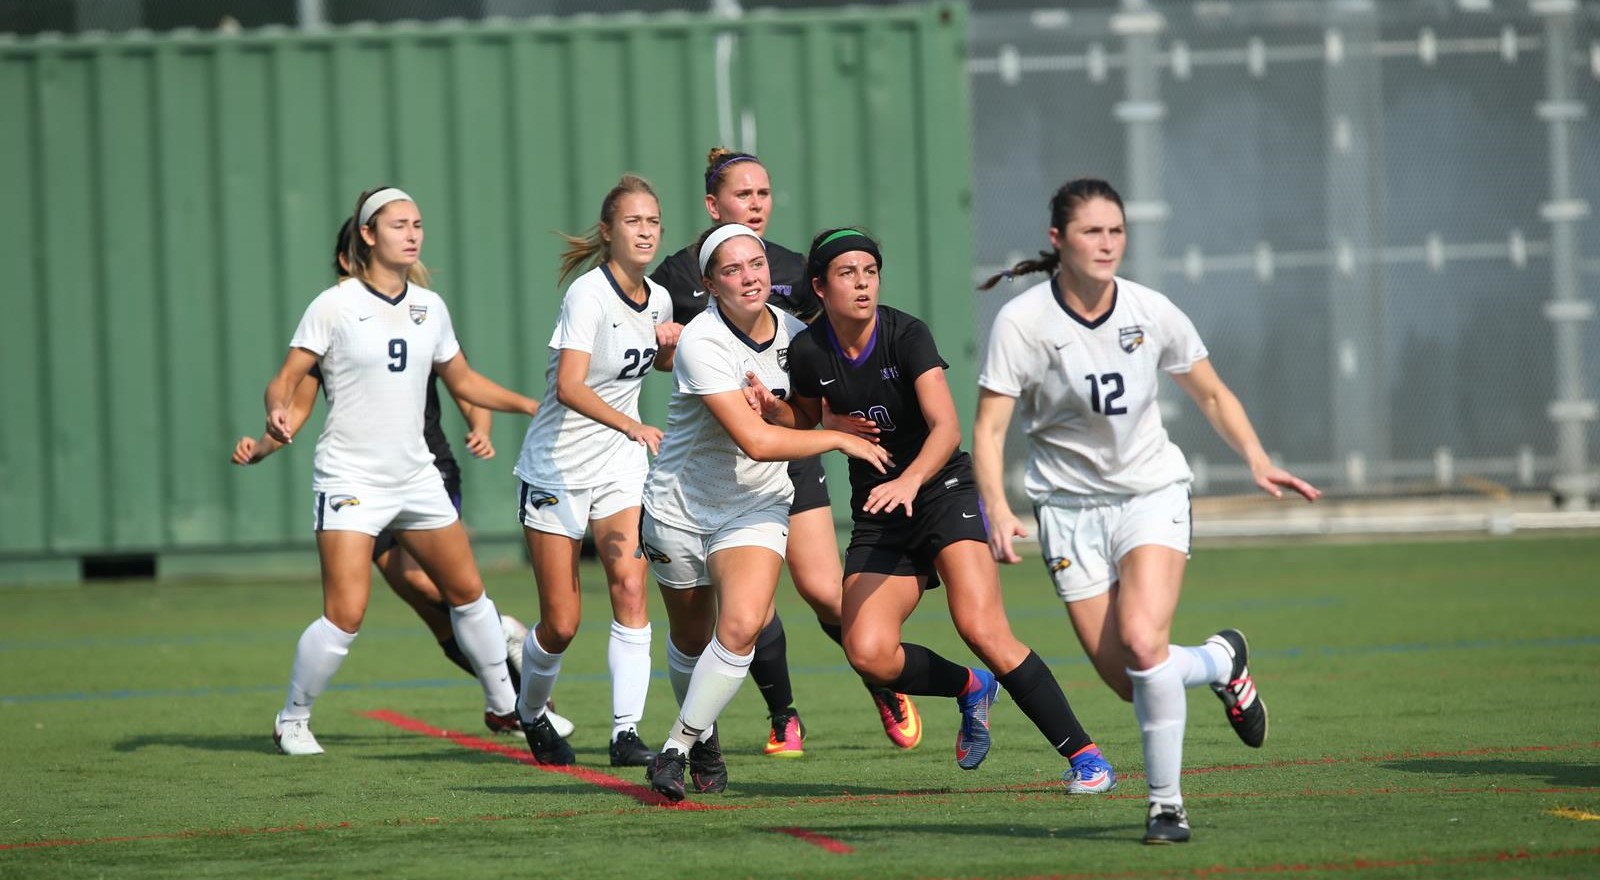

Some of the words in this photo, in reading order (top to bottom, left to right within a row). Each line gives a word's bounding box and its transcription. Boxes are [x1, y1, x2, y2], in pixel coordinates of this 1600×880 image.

[388, 338, 407, 372] 9
[617, 348, 657, 380] 22
[1085, 373, 1128, 415] 12
[849, 405, 897, 432] 0
